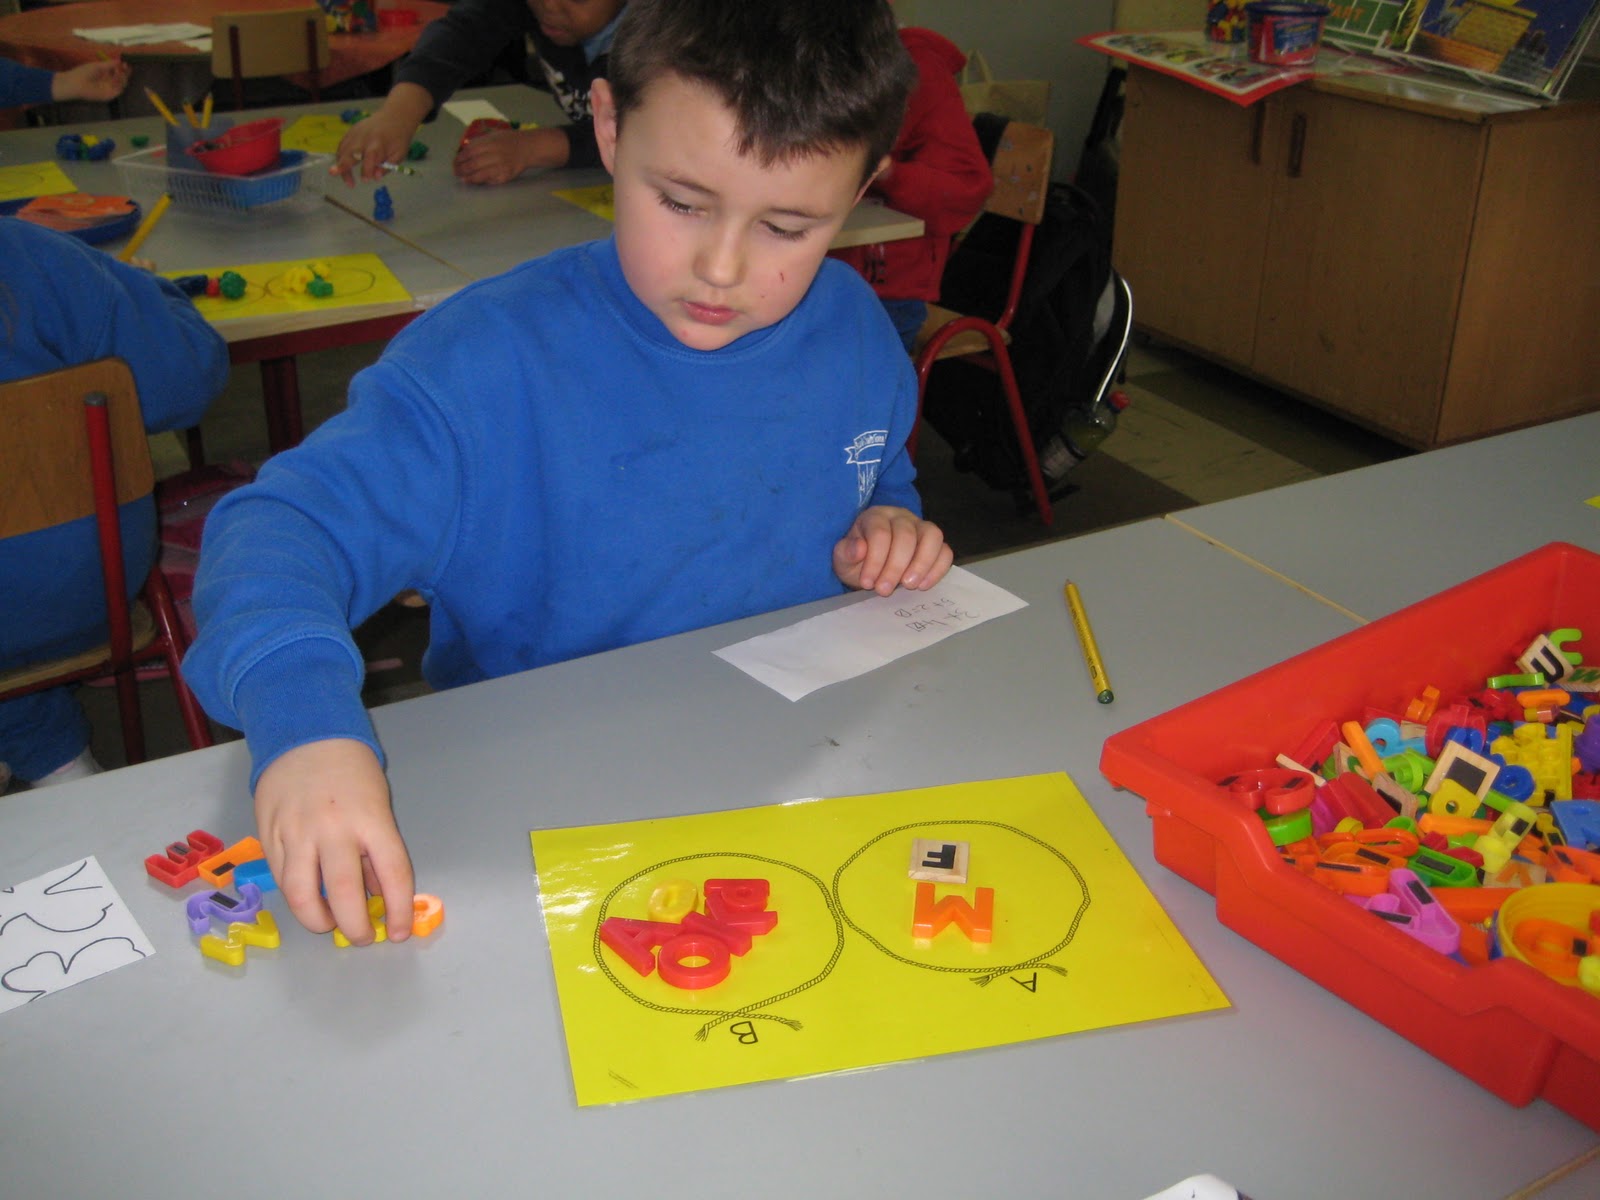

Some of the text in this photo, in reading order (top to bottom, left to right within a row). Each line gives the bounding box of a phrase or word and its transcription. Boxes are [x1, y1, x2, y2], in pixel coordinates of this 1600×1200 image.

[922, 844, 957, 870] F
[1009, 971, 1037, 993] A
[729, 1020, 759, 1045] B
